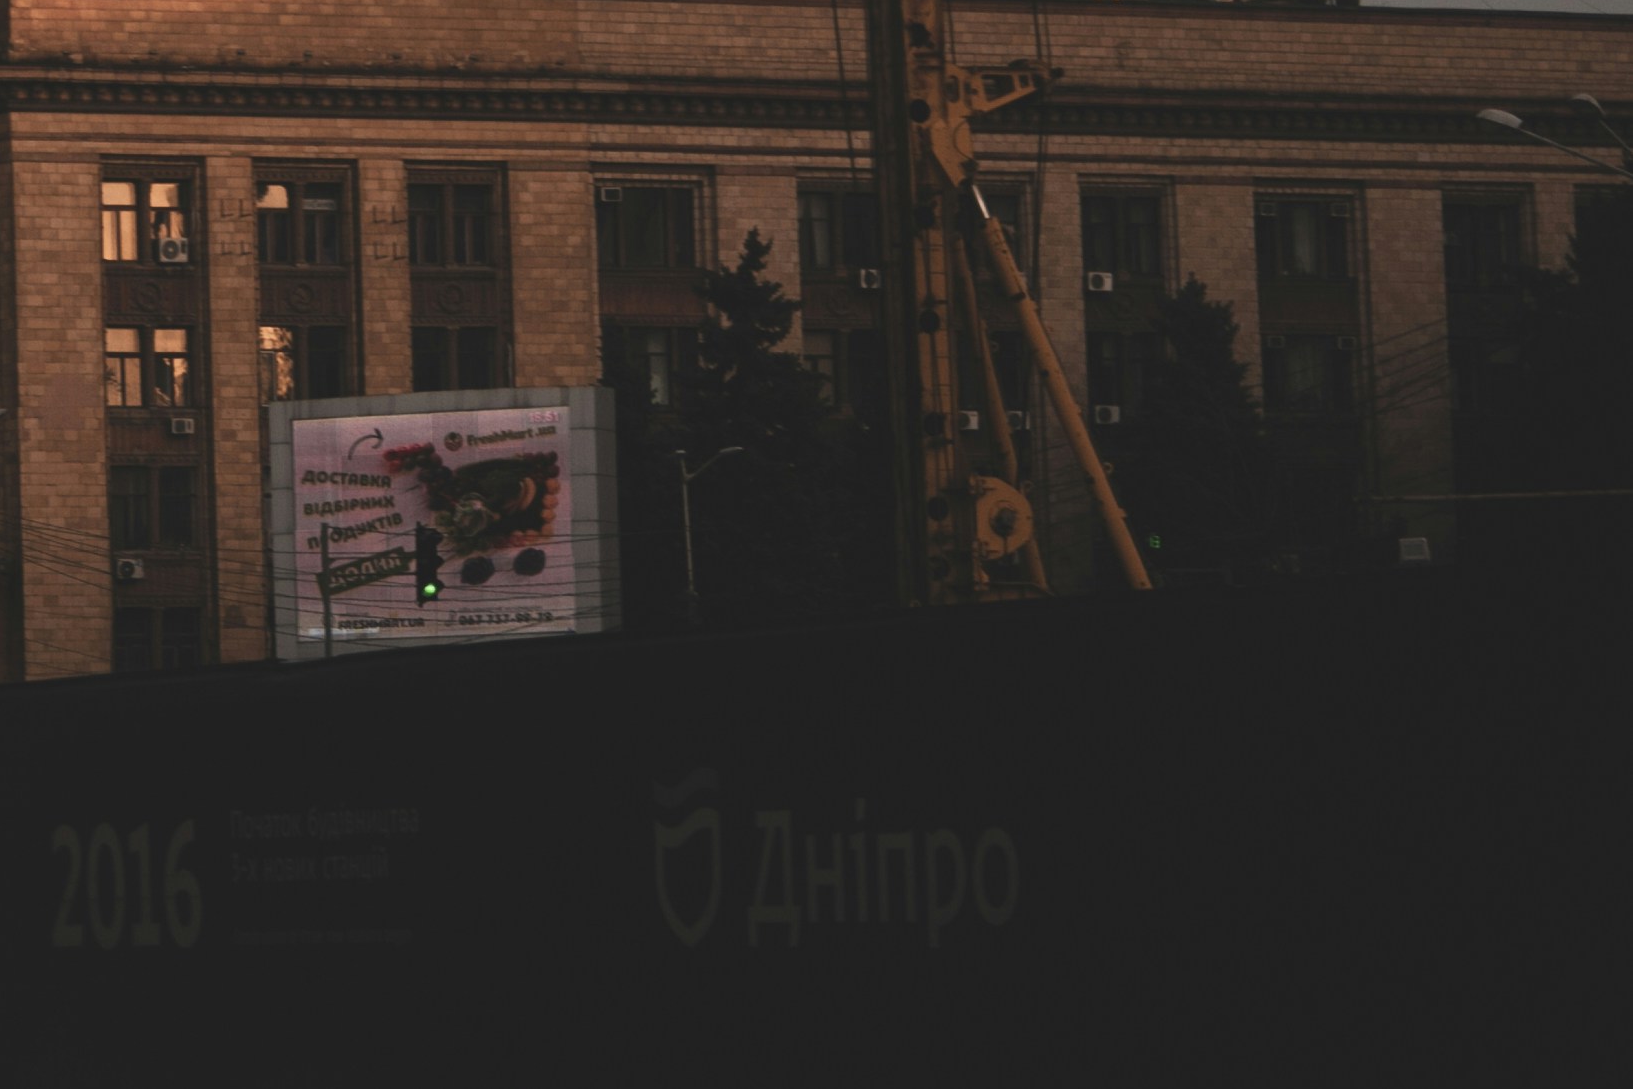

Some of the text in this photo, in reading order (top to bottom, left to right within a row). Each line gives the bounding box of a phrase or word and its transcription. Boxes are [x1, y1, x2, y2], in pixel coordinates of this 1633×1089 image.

[301, 470, 392, 488] ДОСТАВКА
[303, 495, 396, 517] ВІДБІРНИХ
[307, 512, 404, 550] ПОДУКТІВ
[229, 802, 420, 841] Початок будівництва
[263, 854, 317, 882] нових
[322, 846, 390, 882] станцій
[747, 797, 1020, 948] Дніпро
[50, 818, 204, 950] 2016
